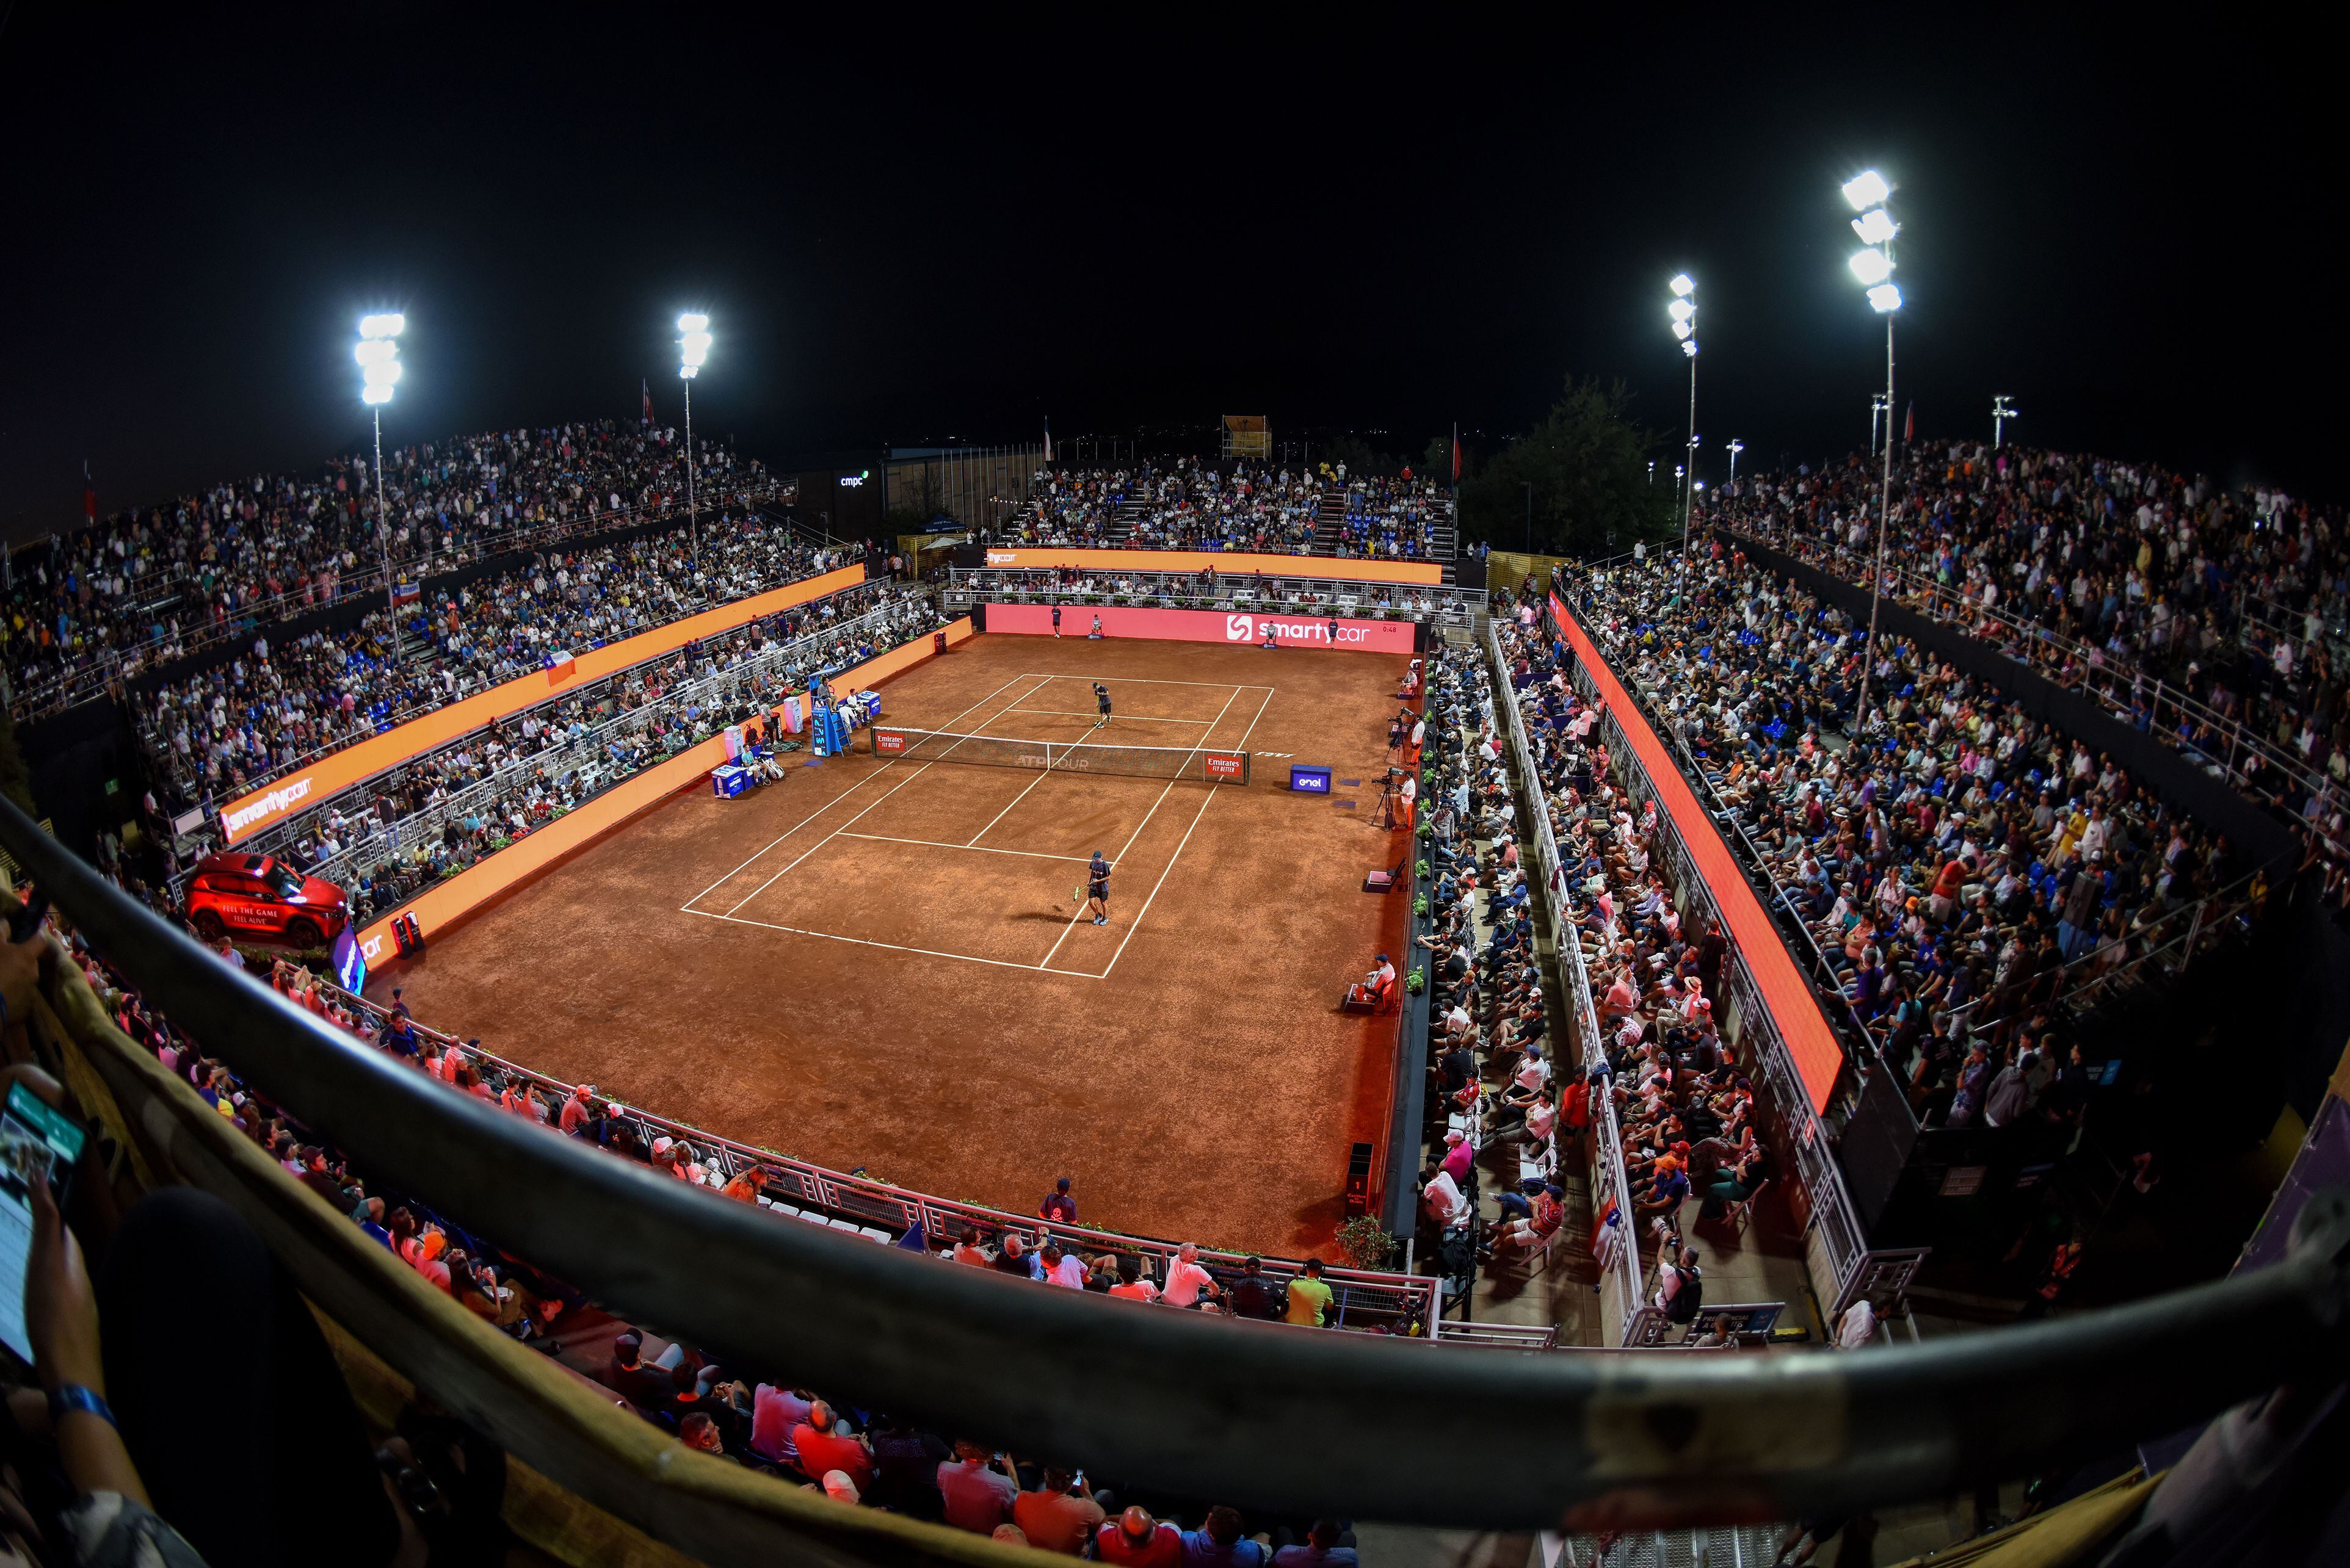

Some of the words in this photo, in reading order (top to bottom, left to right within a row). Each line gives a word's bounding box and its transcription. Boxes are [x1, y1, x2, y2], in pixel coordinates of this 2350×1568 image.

[841, 477, 863, 488] cmpc
[1259, 622, 1371, 644] smartycar
[1015, 754, 1046, 767] ATP
[1050, 757, 1089, 770] TOUR
[1208, 758, 1239, 767] Emirates
[1299, 778, 1321, 787] enel
[256, 909, 278, 917] GAME
[1355, 1181, 1360, 1190] 1
